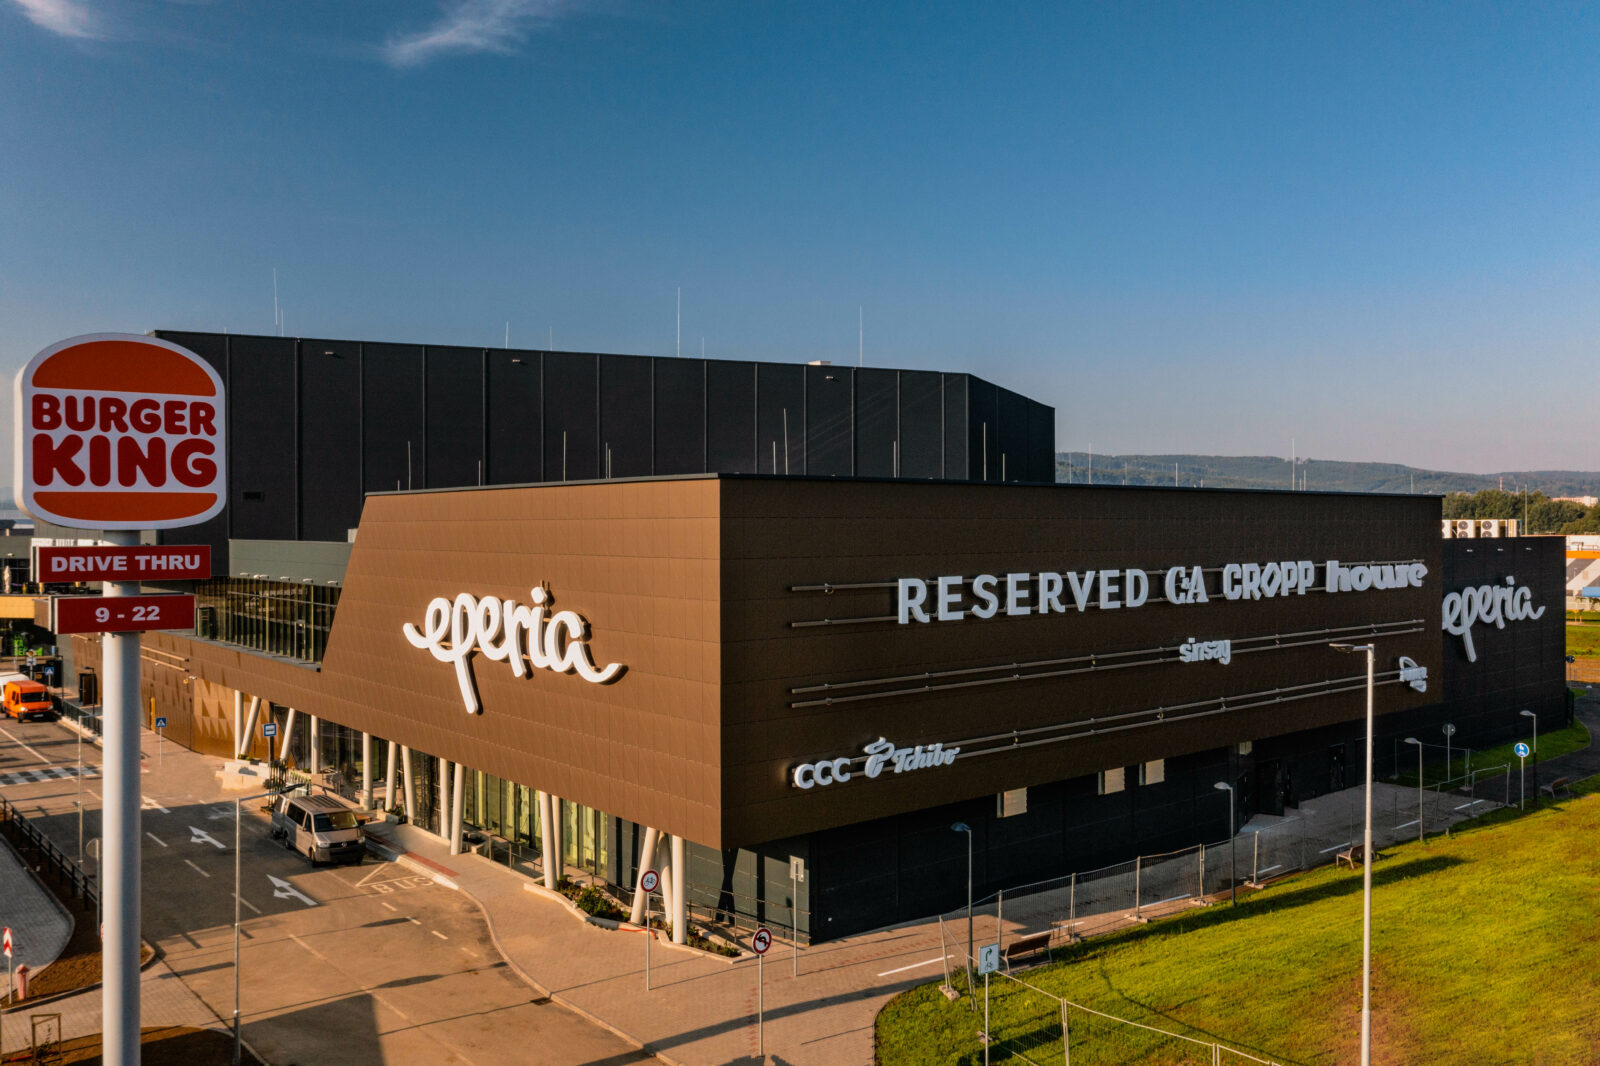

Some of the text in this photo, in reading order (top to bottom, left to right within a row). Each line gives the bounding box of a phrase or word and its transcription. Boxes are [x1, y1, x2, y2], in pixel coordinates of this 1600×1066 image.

[32, 393, 217, 436] BURGER
[32, 433, 218, 488] KING
[51, 554, 200, 572] DRIVE THRU
[95, 607, 110, 622] 9
[132, 605, 160, 621] 22
[898, 568, 1149, 625] RESERVED
[1164, 565, 1209, 605] C&A
[1222, 560, 1316, 603] CROPP
[1443, 575, 1546, 663] eperia
[403, 586, 623, 714] eperia
[1179, 637, 1232, 665] sinsay
[793, 742, 961, 790] CCC Tchibo
[371, 876, 434, 894] BUS
